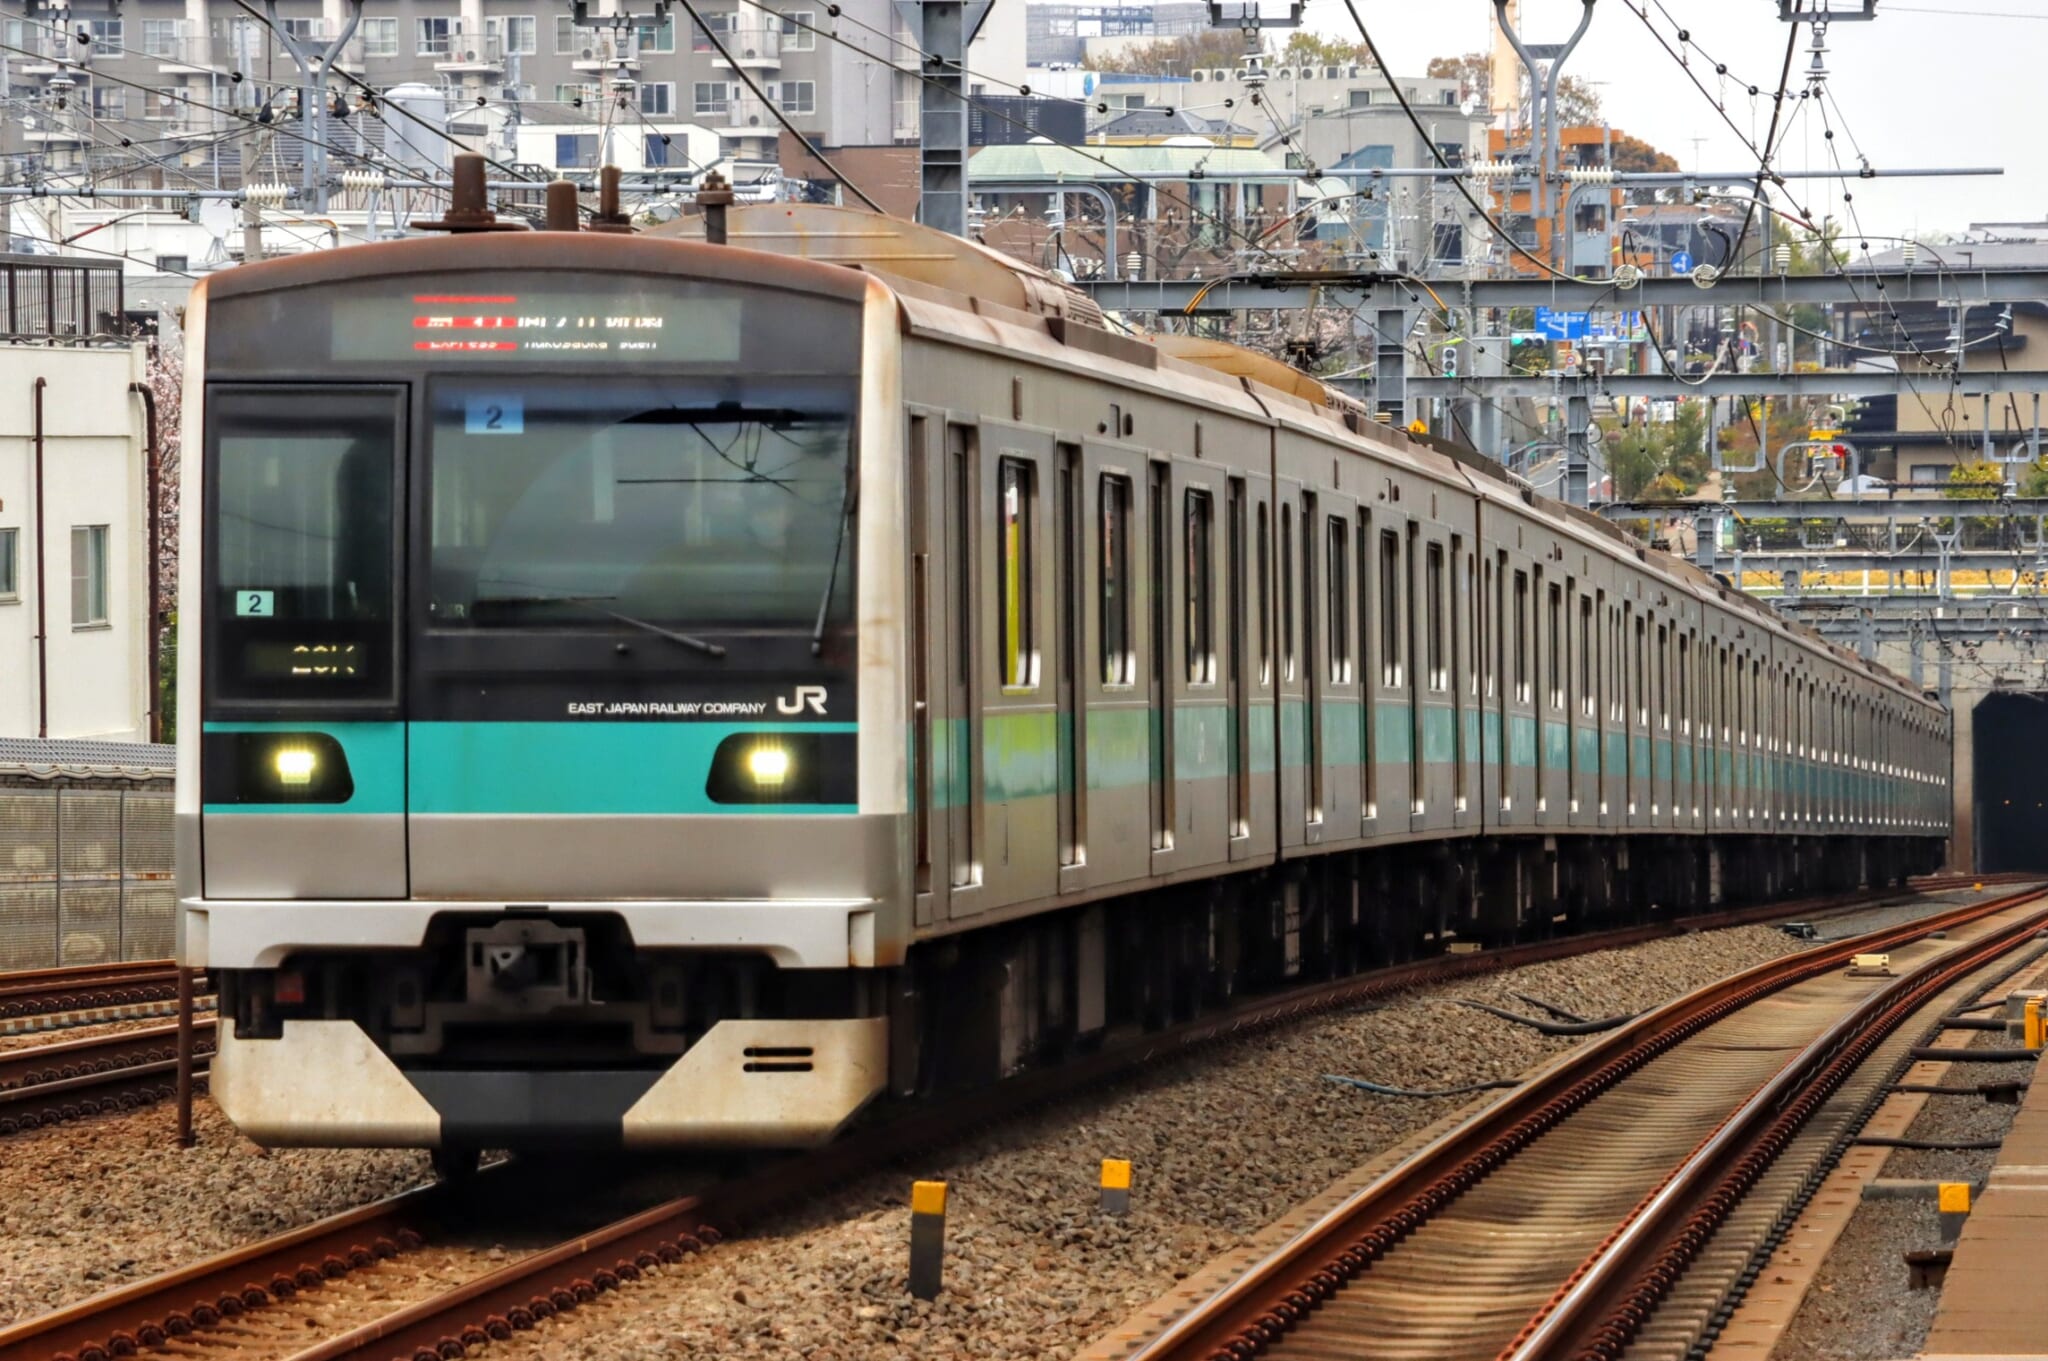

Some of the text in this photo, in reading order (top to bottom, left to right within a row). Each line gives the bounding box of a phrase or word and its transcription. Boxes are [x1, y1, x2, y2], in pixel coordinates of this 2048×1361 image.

[486, 405, 504, 430] 2
[248, 594, 262, 613] 2
[567, 702, 767, 714] EAST JAPAN RAILWAY COMPANY
[776, 685, 828, 715] JR
